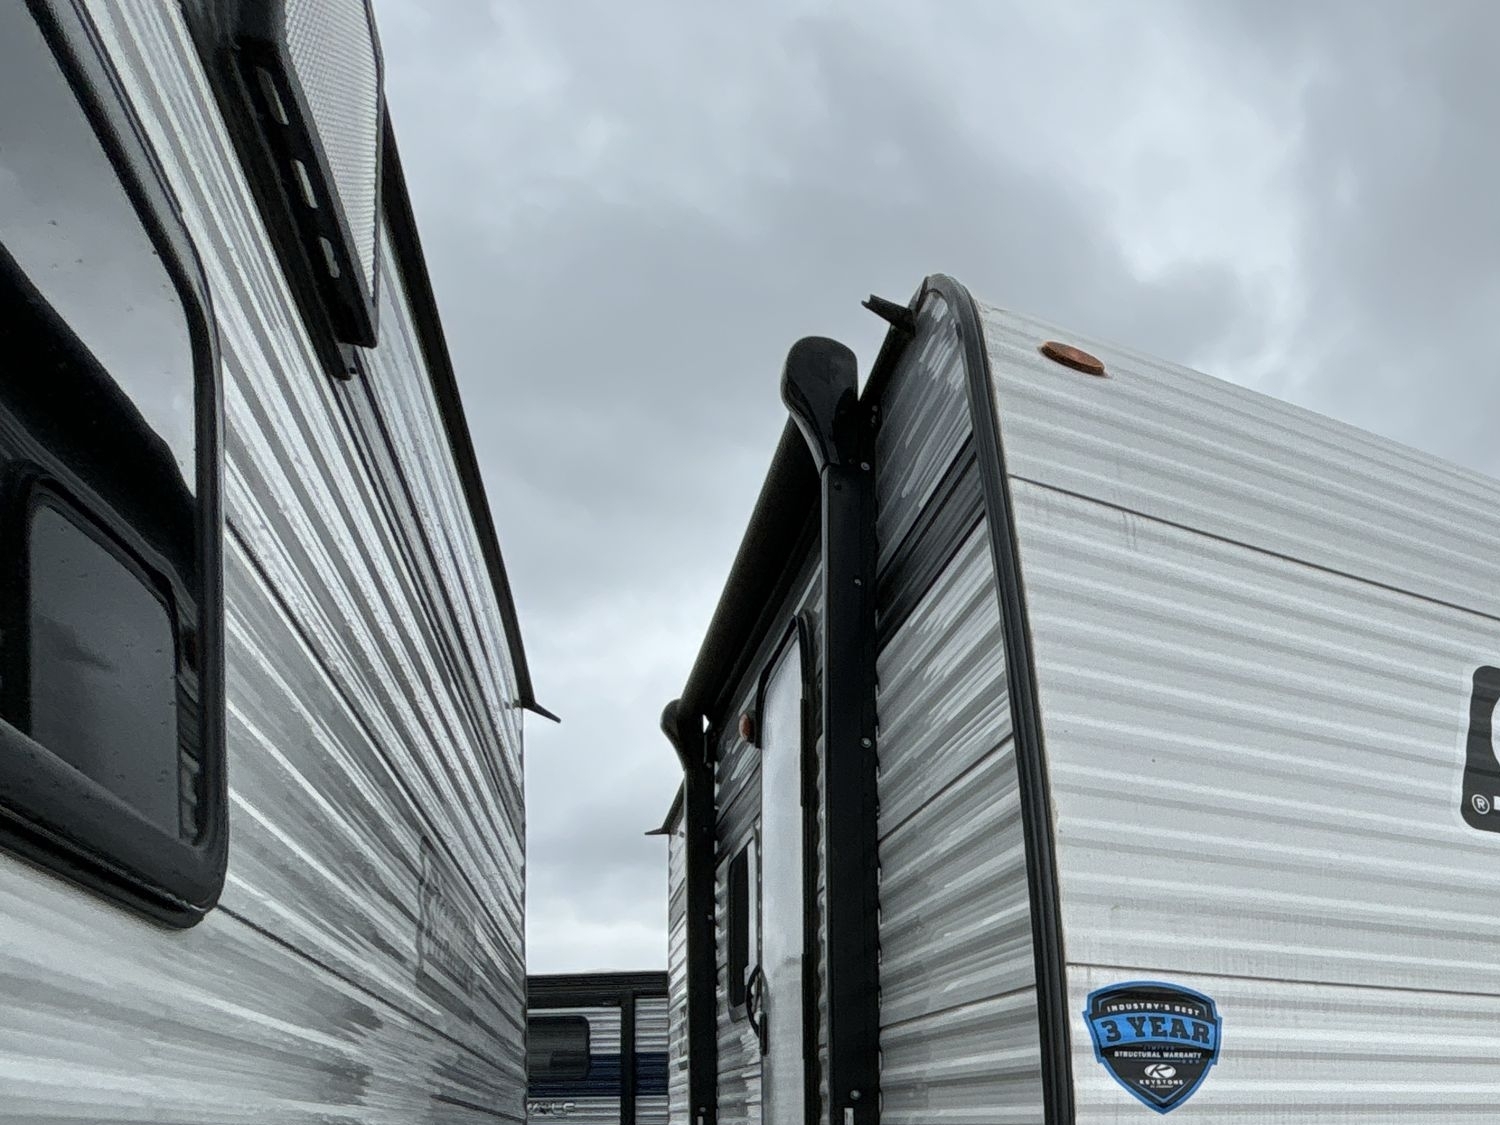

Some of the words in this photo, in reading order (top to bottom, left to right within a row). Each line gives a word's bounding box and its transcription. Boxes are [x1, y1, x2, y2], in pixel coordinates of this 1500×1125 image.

[1107, 1003, 1170, 1013] INDUSTRY'S
[1174, 1006, 1200, 1016] BEST
[1101, 1020, 1122, 1042] 3
[1126, 1016, 1210, 1044] YEAR
